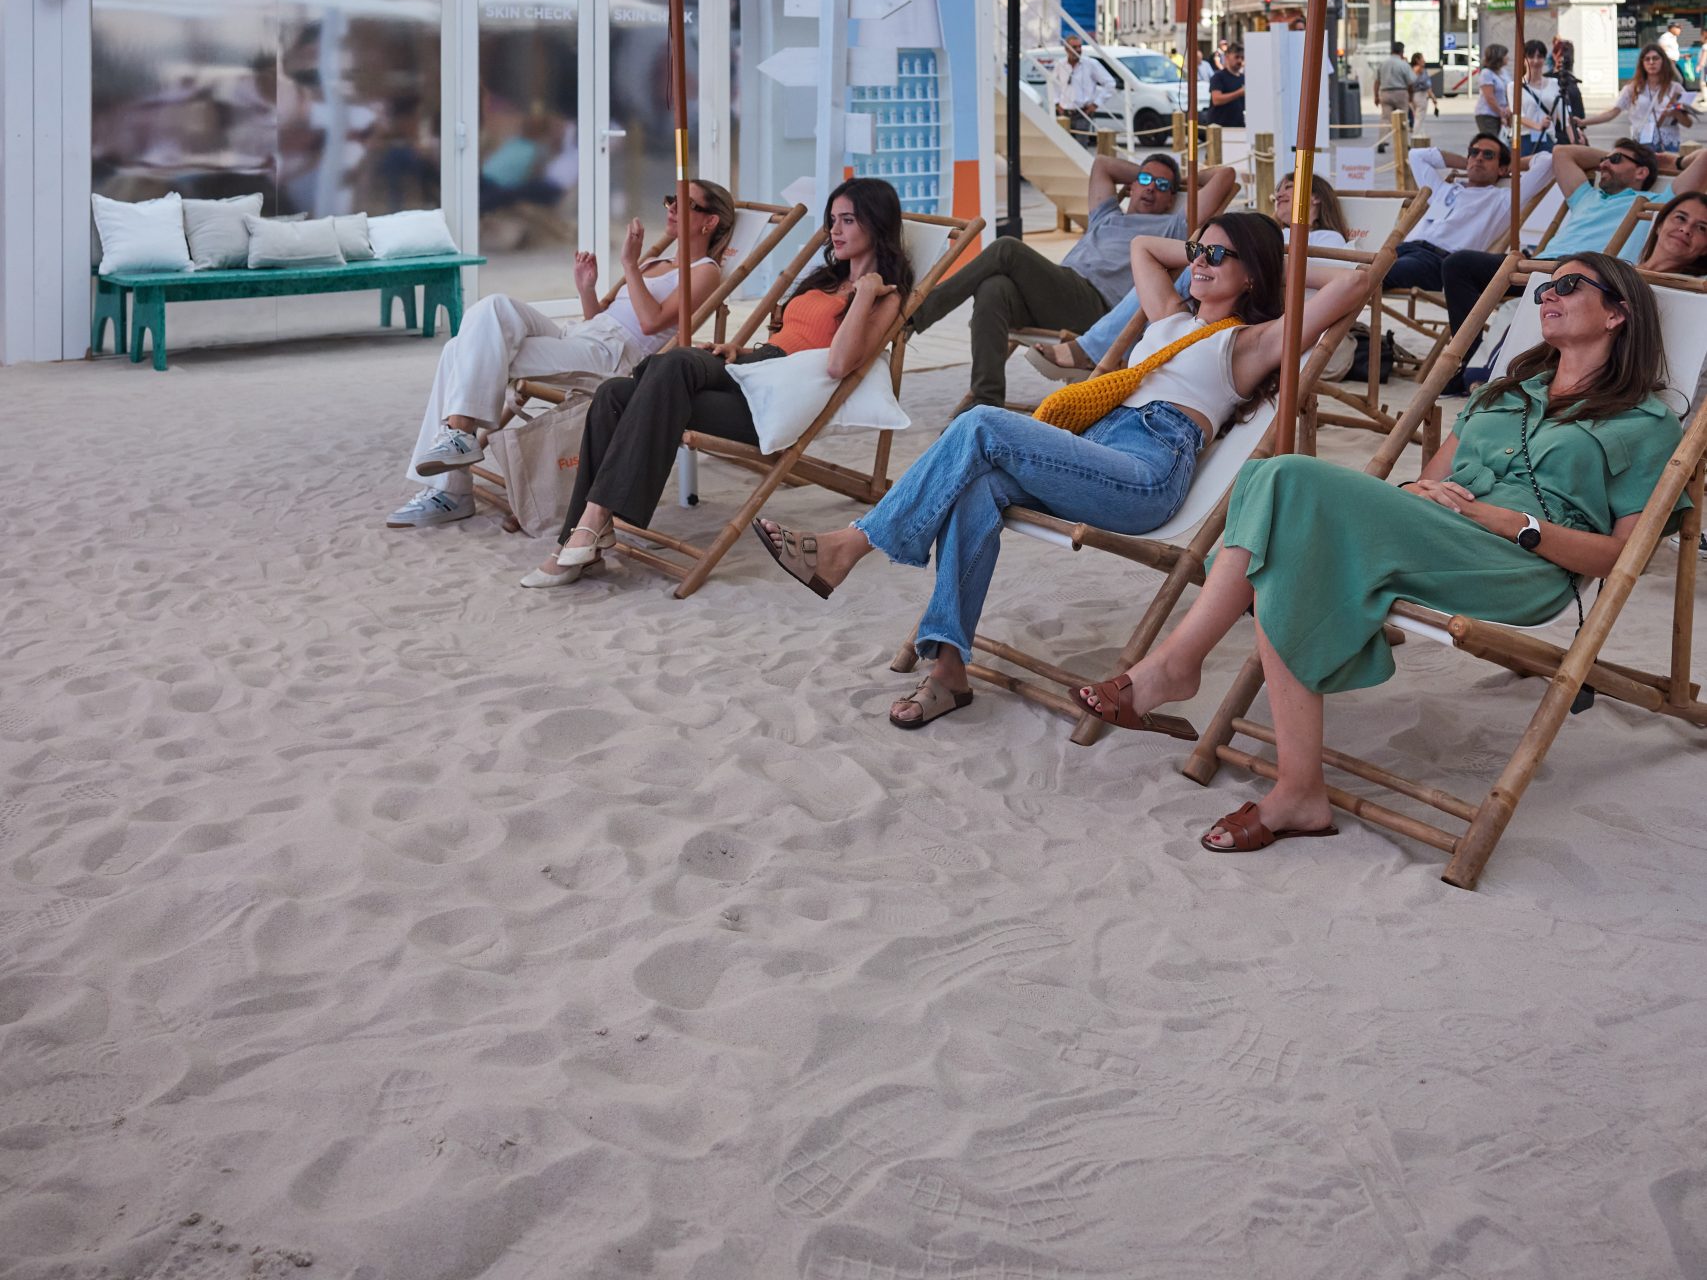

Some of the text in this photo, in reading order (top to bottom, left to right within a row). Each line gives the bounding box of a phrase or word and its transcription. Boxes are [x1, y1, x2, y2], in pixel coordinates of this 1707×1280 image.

[485, 6, 573, 20] SKIN CHECK
[614, 7, 693, 24] SKIN CHK
